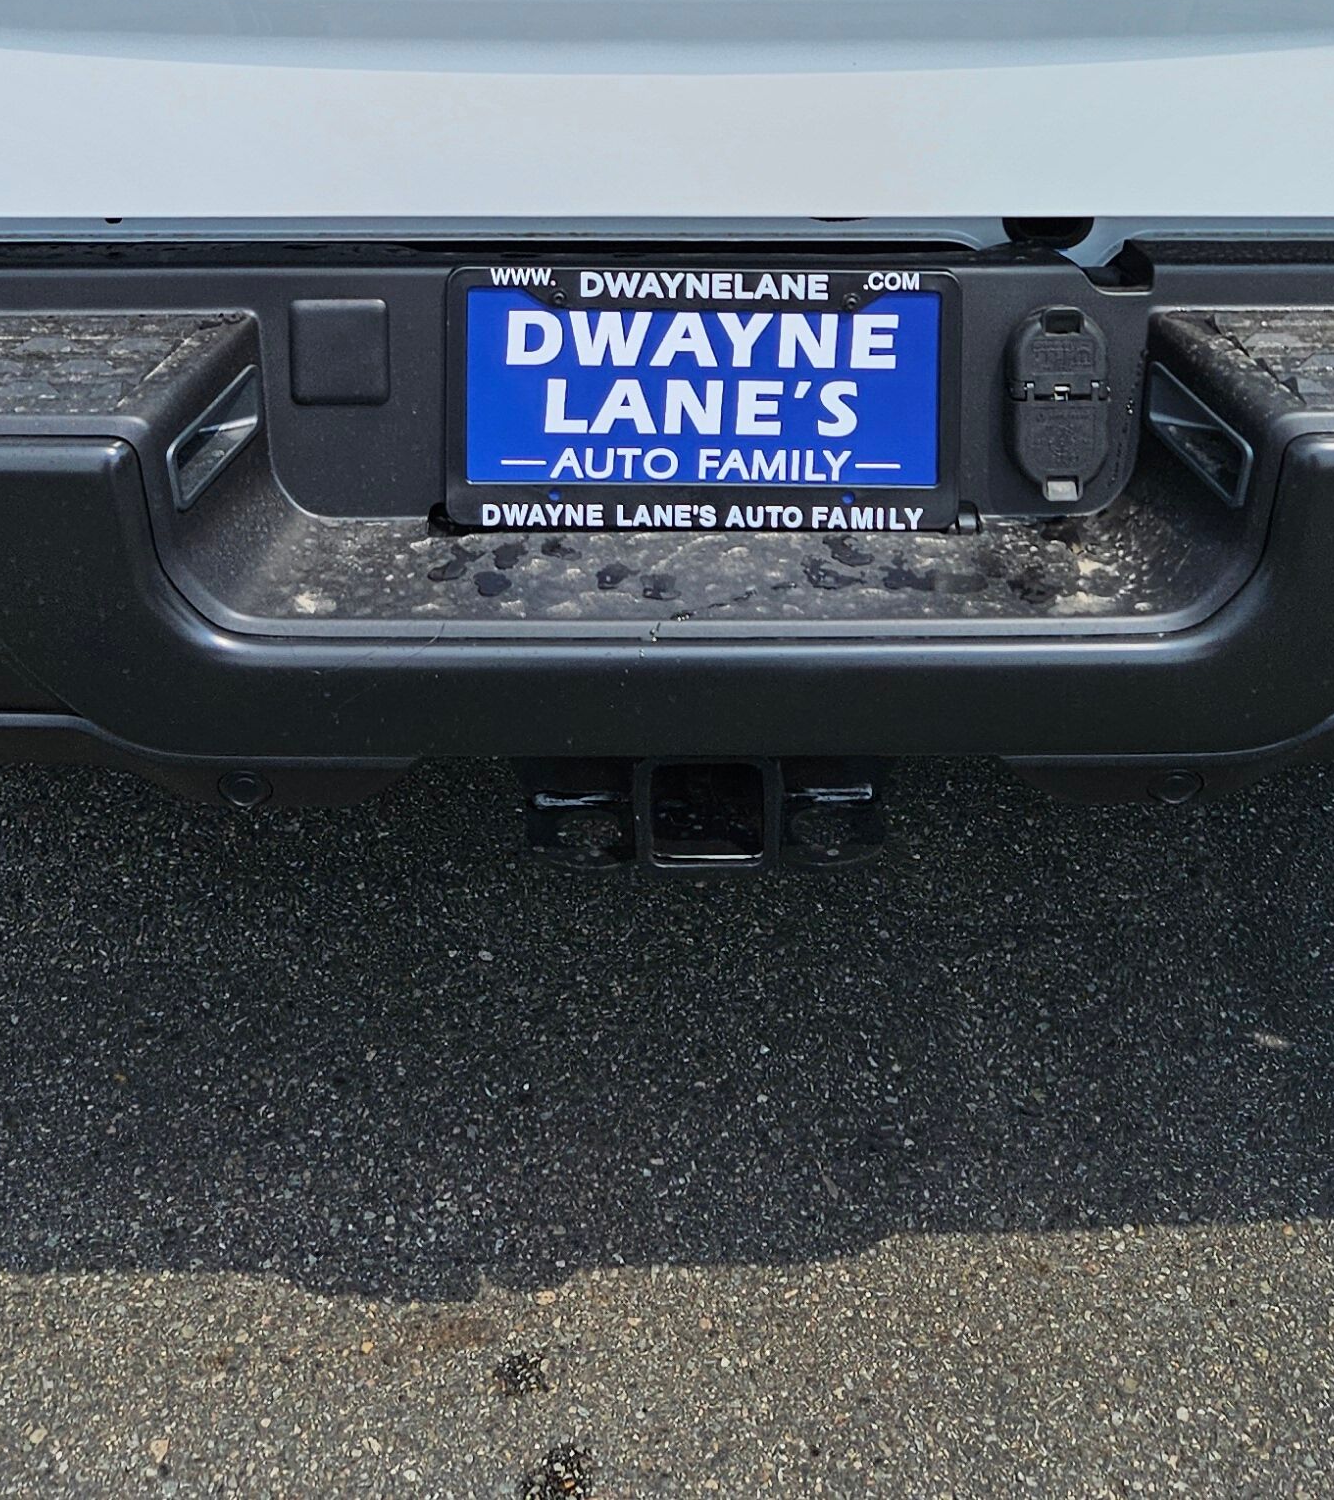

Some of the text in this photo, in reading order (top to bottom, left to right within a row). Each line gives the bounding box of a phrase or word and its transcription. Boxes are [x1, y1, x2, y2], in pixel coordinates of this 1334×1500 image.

[580, 271, 829, 300] DWAYNELANE
[863, 272, 921, 291] .COM
[505, 309, 900, 369] DWAYNE
[544, 378, 858, 437] LANE'S
[549, 447, 853, 482] AUTO FAMILY
[482, 503, 924, 531] DWAYNE LANE'S AUTO FAMILY
